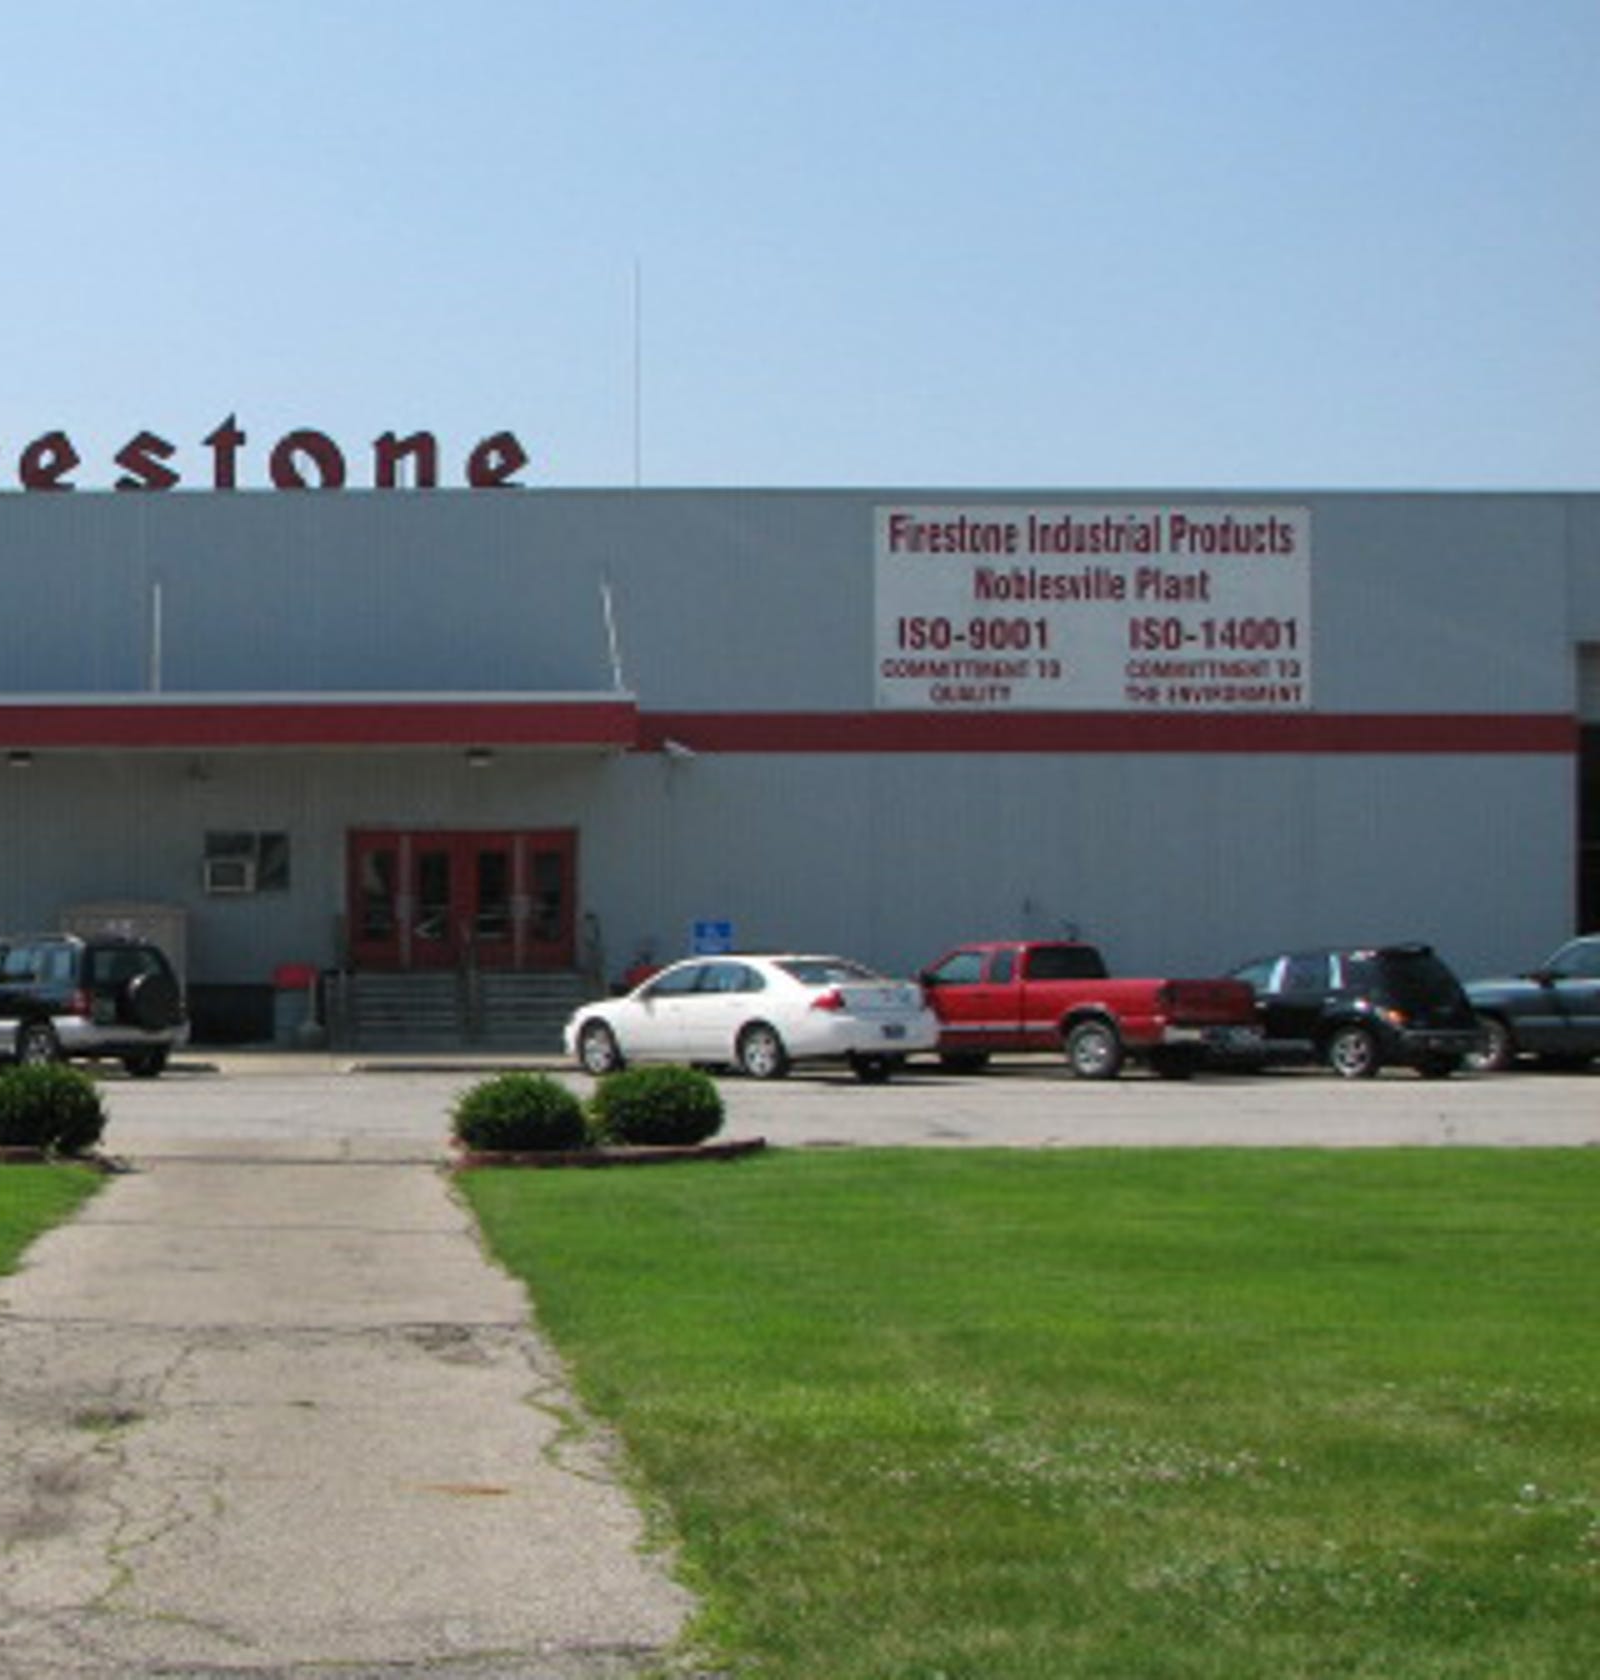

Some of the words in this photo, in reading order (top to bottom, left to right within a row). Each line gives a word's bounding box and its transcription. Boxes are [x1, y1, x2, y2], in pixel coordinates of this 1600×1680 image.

[889, 514, 1017, 553] Firestone
[1029, 514, 1160, 553] Industrial
[1171, 514, 1294, 553] Products
[975, 567, 1125, 600] Noblesville
[1136, 567, 1210, 601] Plant
[899, 616, 1050, 650] ISO-9001
[1130, 616, 1298, 650] ISO-14001
[929, 684, 1012, 704] QUALITY
